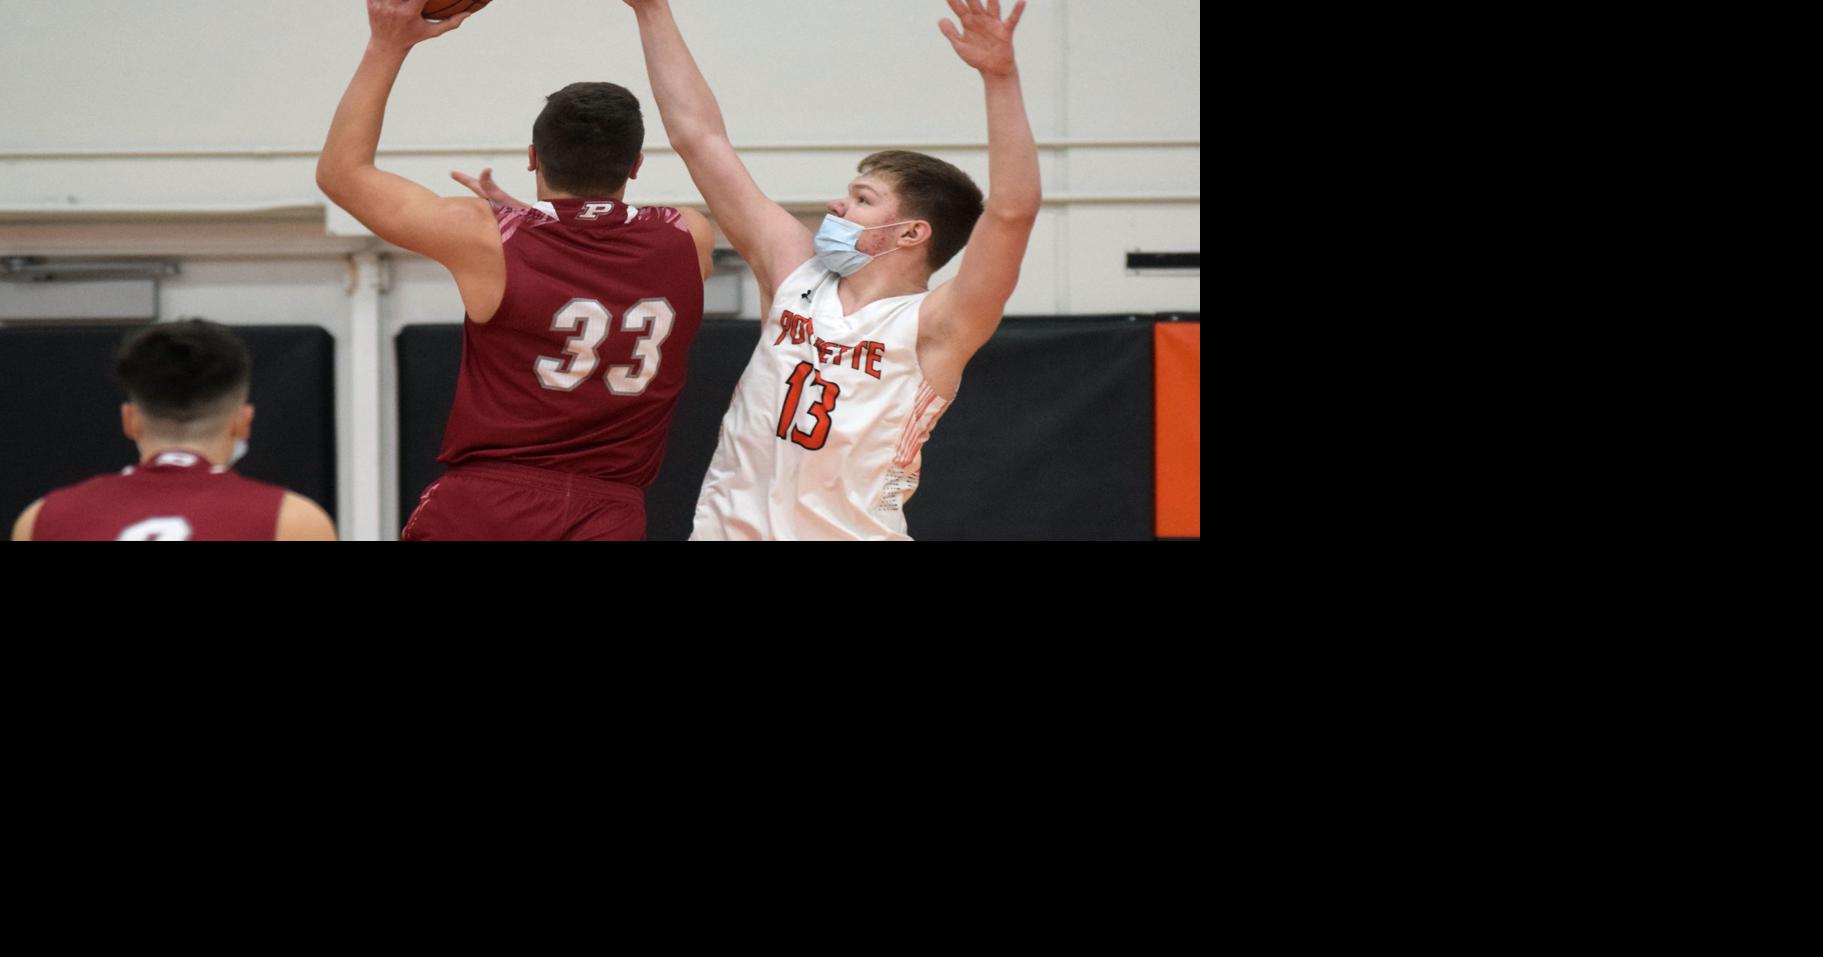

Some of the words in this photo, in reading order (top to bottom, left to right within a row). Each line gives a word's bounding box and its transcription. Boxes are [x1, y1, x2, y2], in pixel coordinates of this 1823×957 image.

[576, 201, 614, 221] P
[533, 297, 676, 396] 33
[774, 309, 885, 380] POETTE
[776, 360, 840, 451] 13
